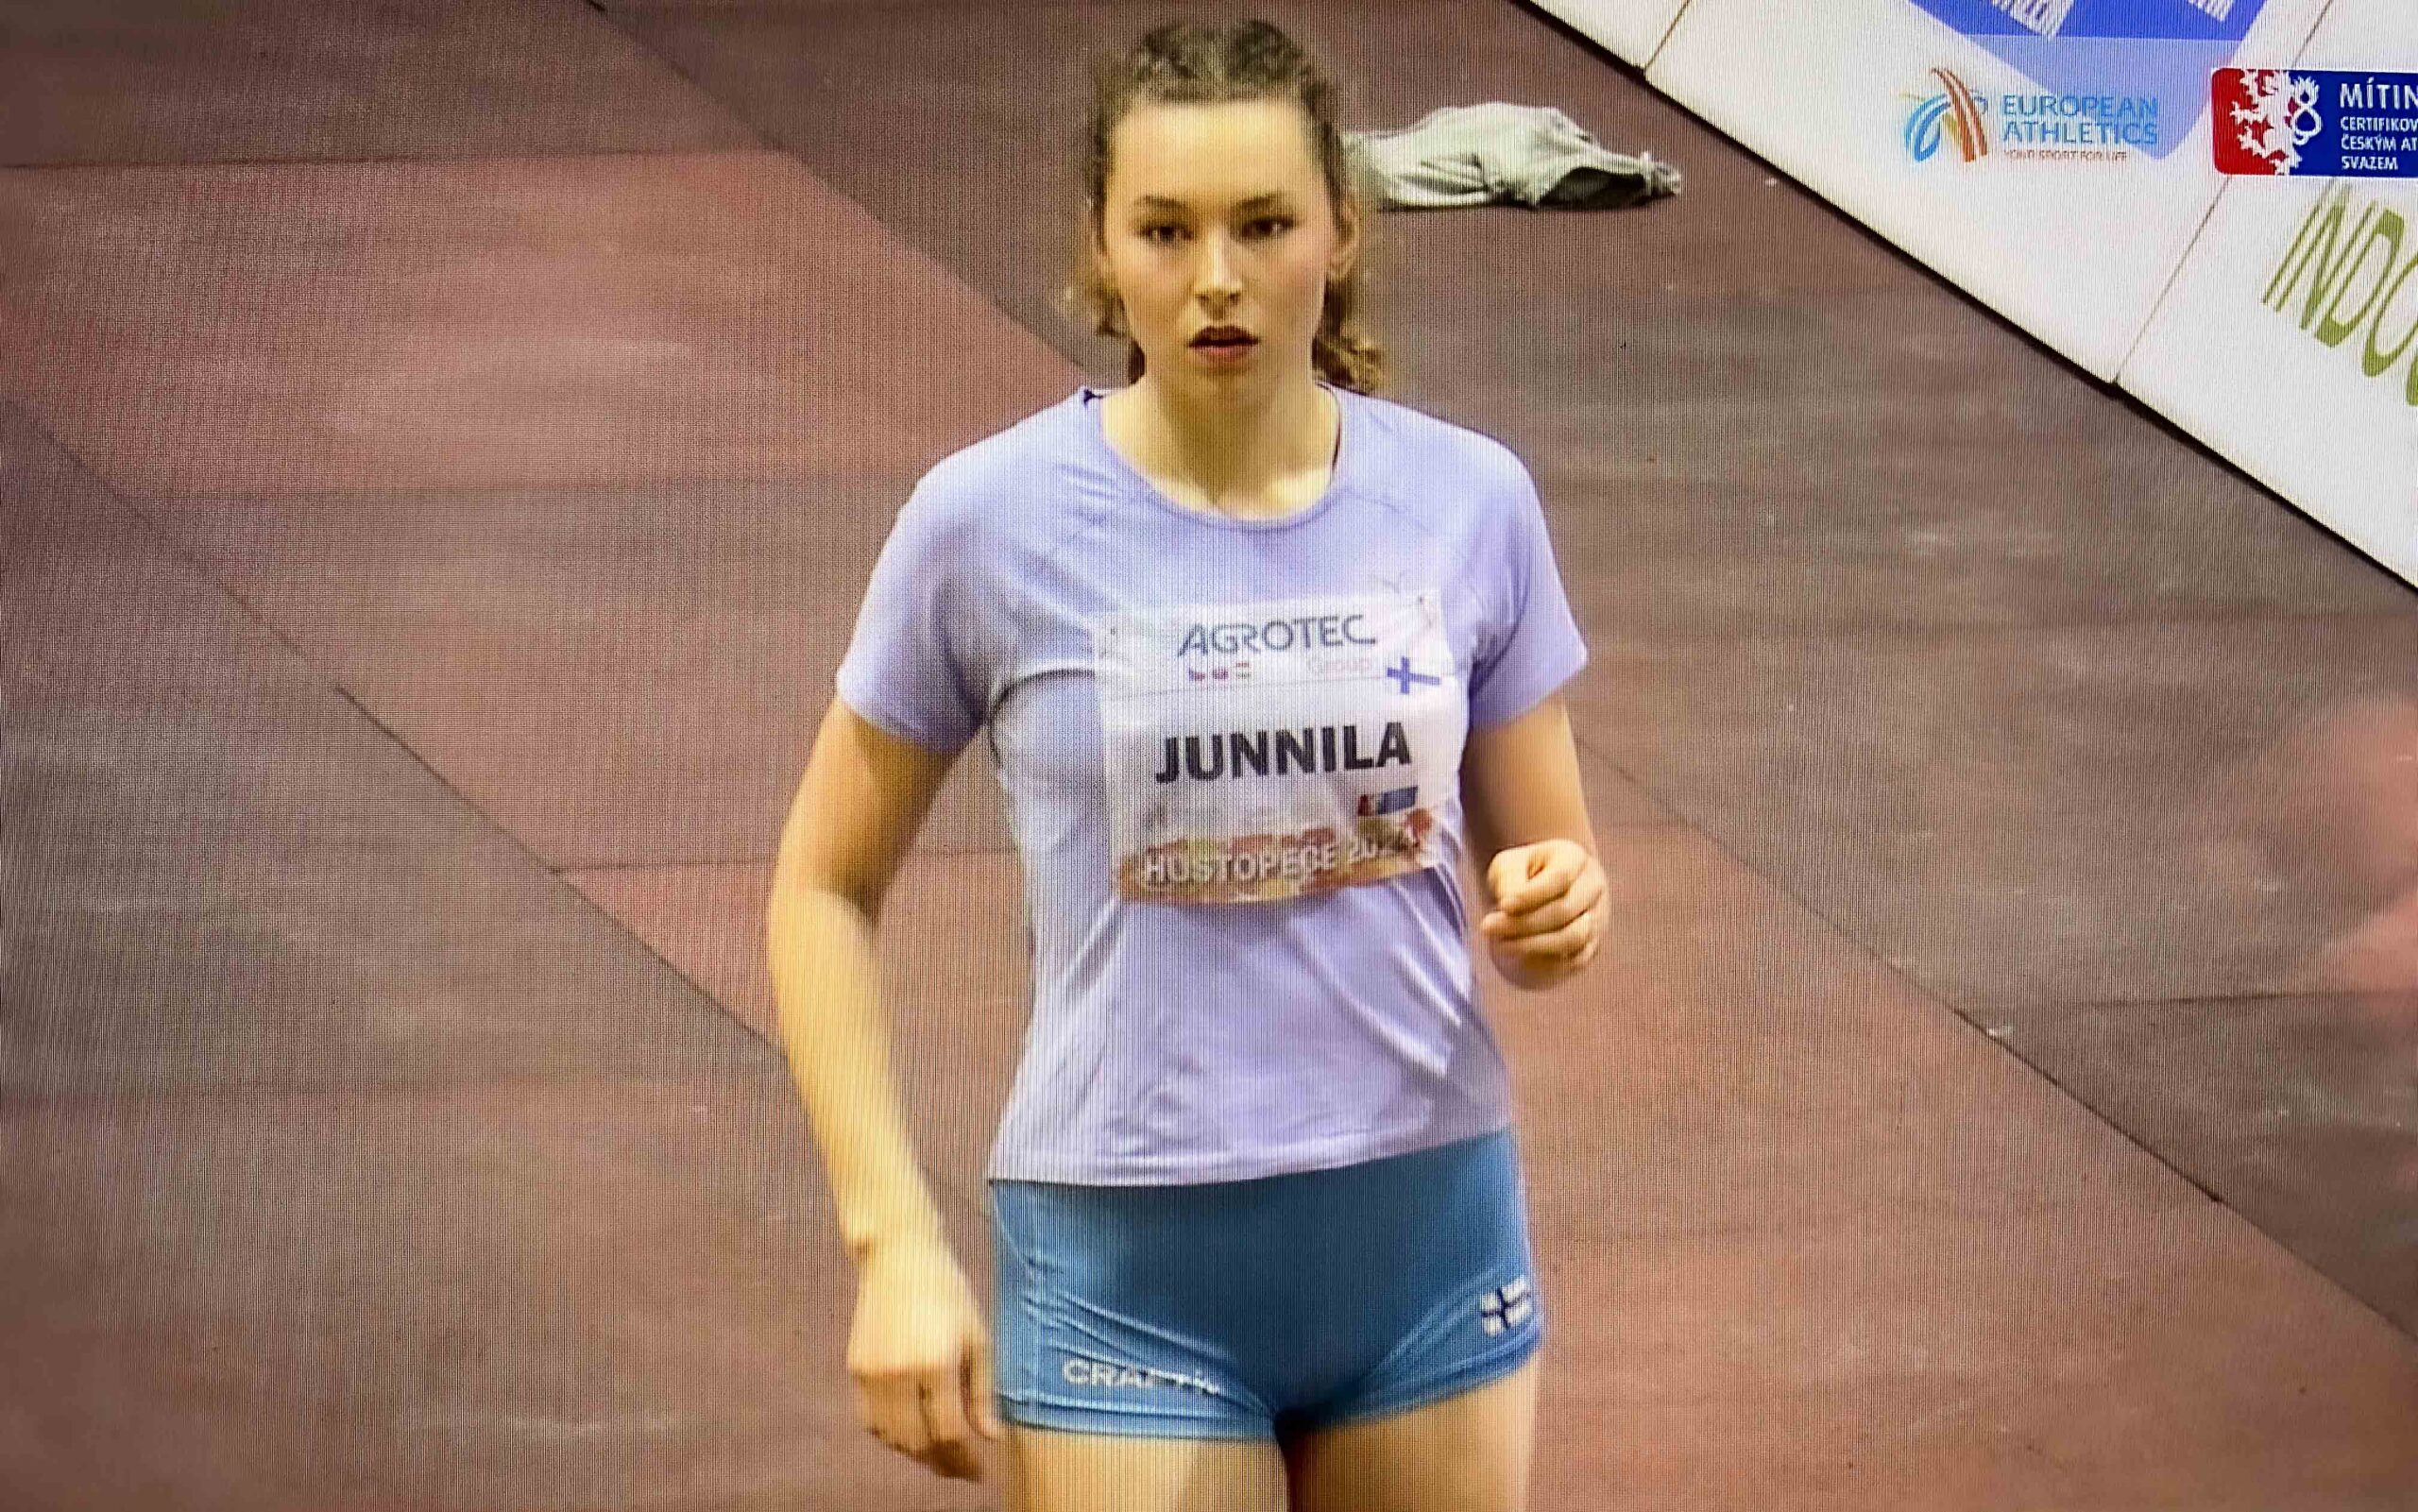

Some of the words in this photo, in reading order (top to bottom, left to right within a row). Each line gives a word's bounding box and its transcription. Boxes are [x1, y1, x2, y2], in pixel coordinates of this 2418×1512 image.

[2340, 76, 2418, 110] MÍTIN
[2003, 94, 2158, 118] EUROPEAN
[2002, 122, 2158, 144] ATHLETICS
[2341, 116, 2418, 132] CERTIFIKOV
[2341, 133, 2396, 151] ČESKÝM
[2038, 149, 2077, 161] SPORT
[2080, 150, 2103, 161] FOR
[2341, 155, 2398, 170] SVAZEM
[2261, 178, 2418, 406] INDO
[1178, 614, 1376, 657] AGROTEC
[1155, 722, 1412, 784] JUNNILA
